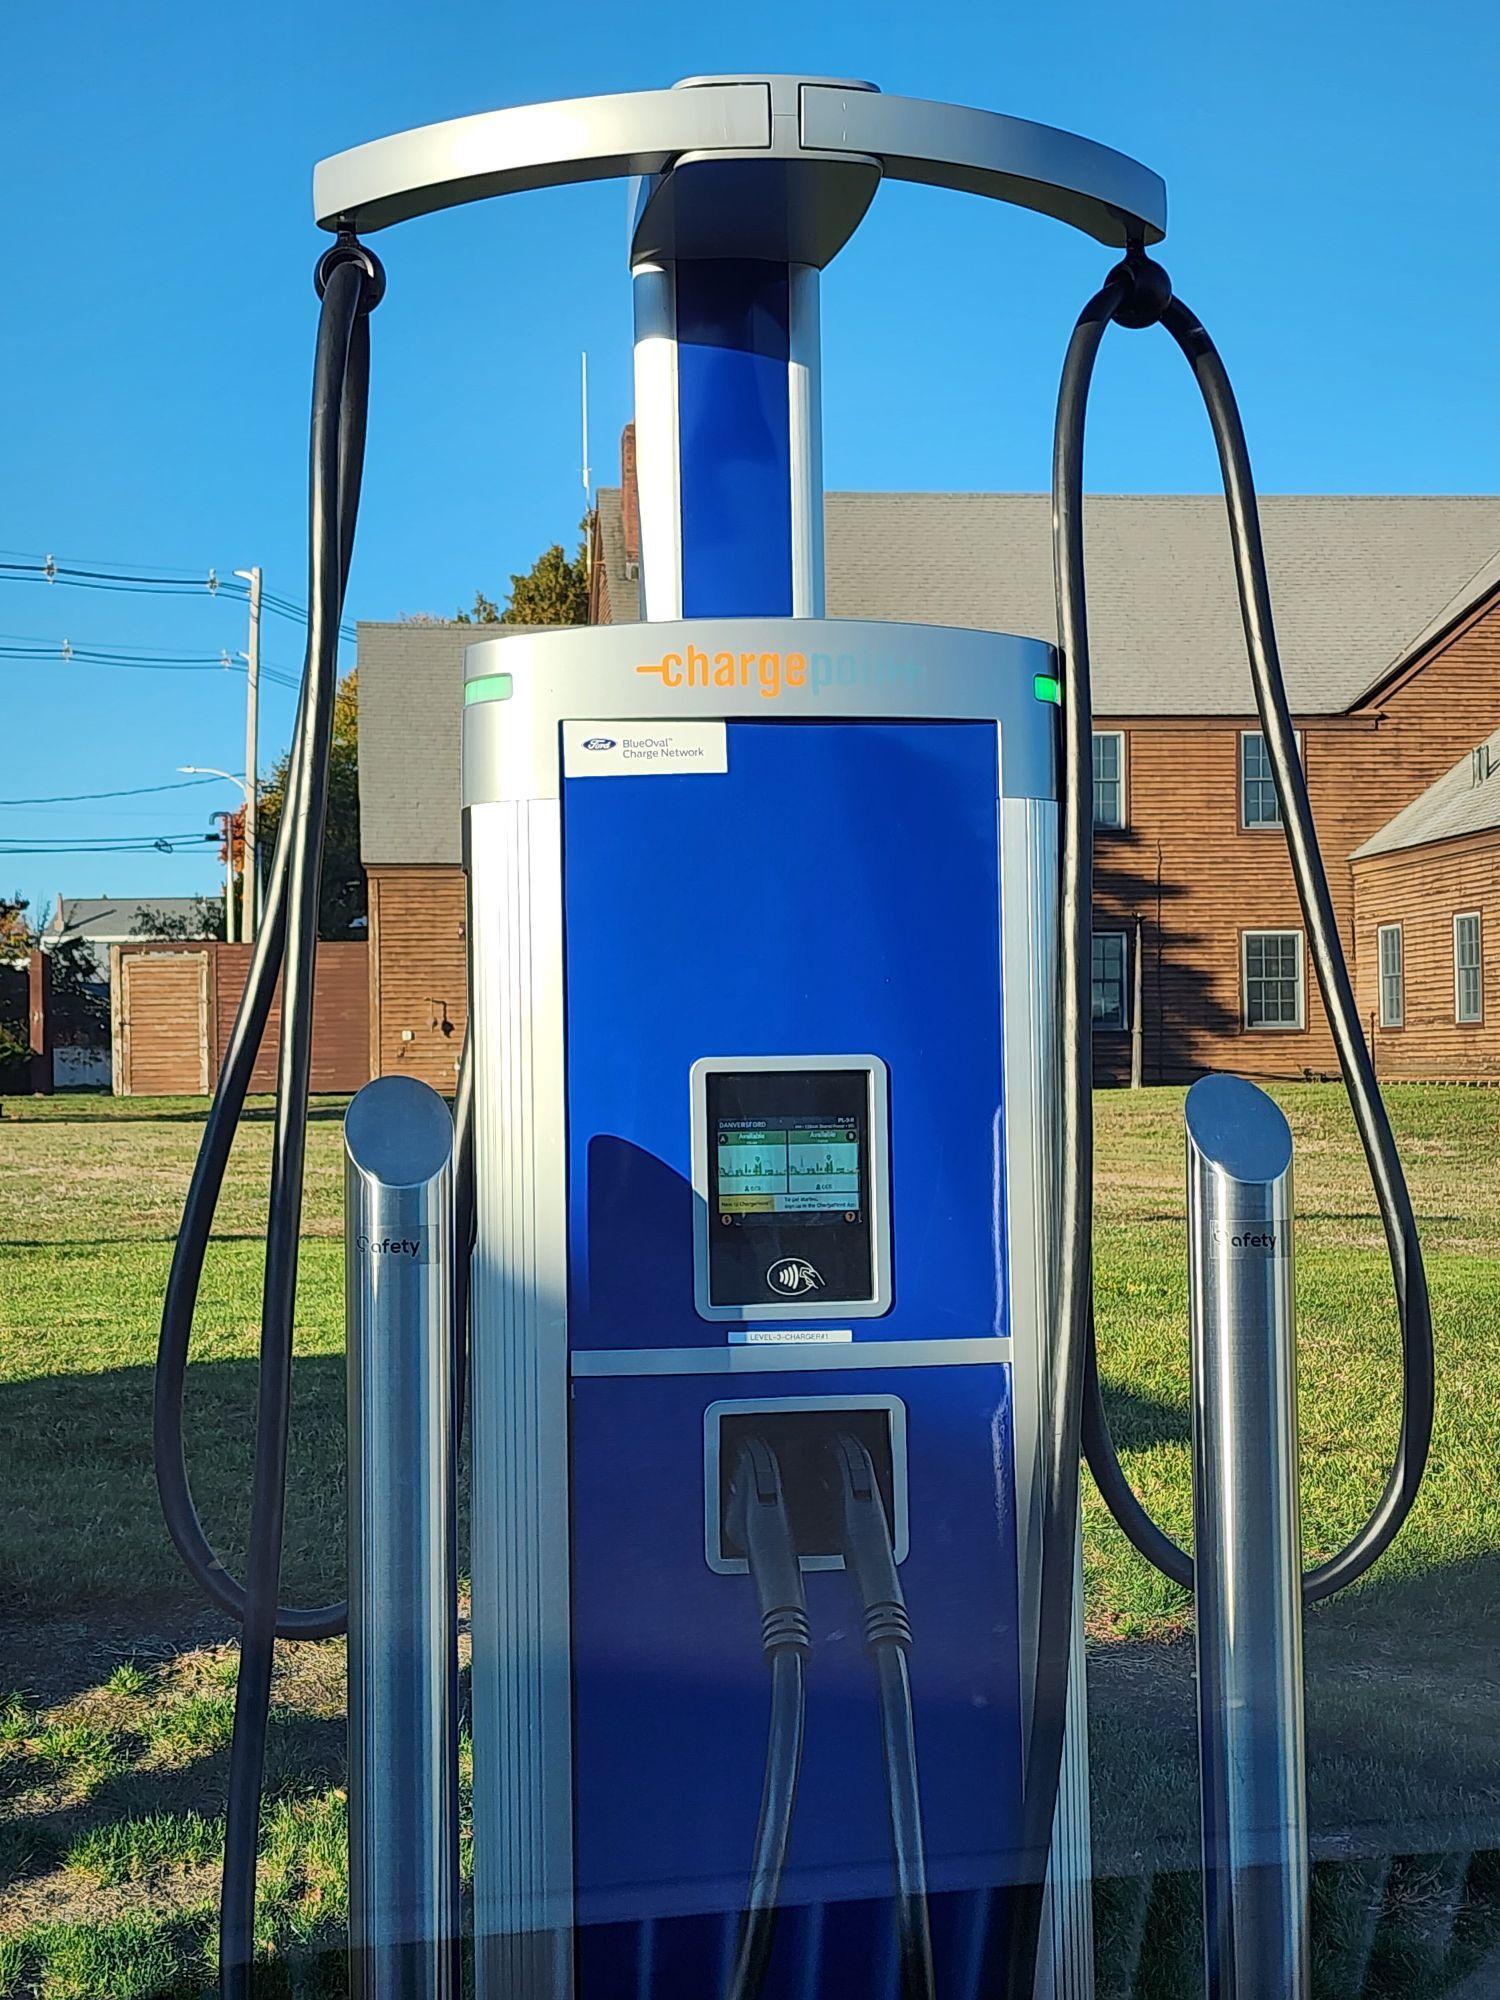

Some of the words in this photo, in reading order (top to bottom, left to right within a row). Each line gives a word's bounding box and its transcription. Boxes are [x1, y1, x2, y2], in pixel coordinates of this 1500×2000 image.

[660, 644, 925, 699] chargepoint
[586, 738, 613, 751] Ford
[622, 749, 659, 760] Charge
[661, 747, 705, 758] Network
